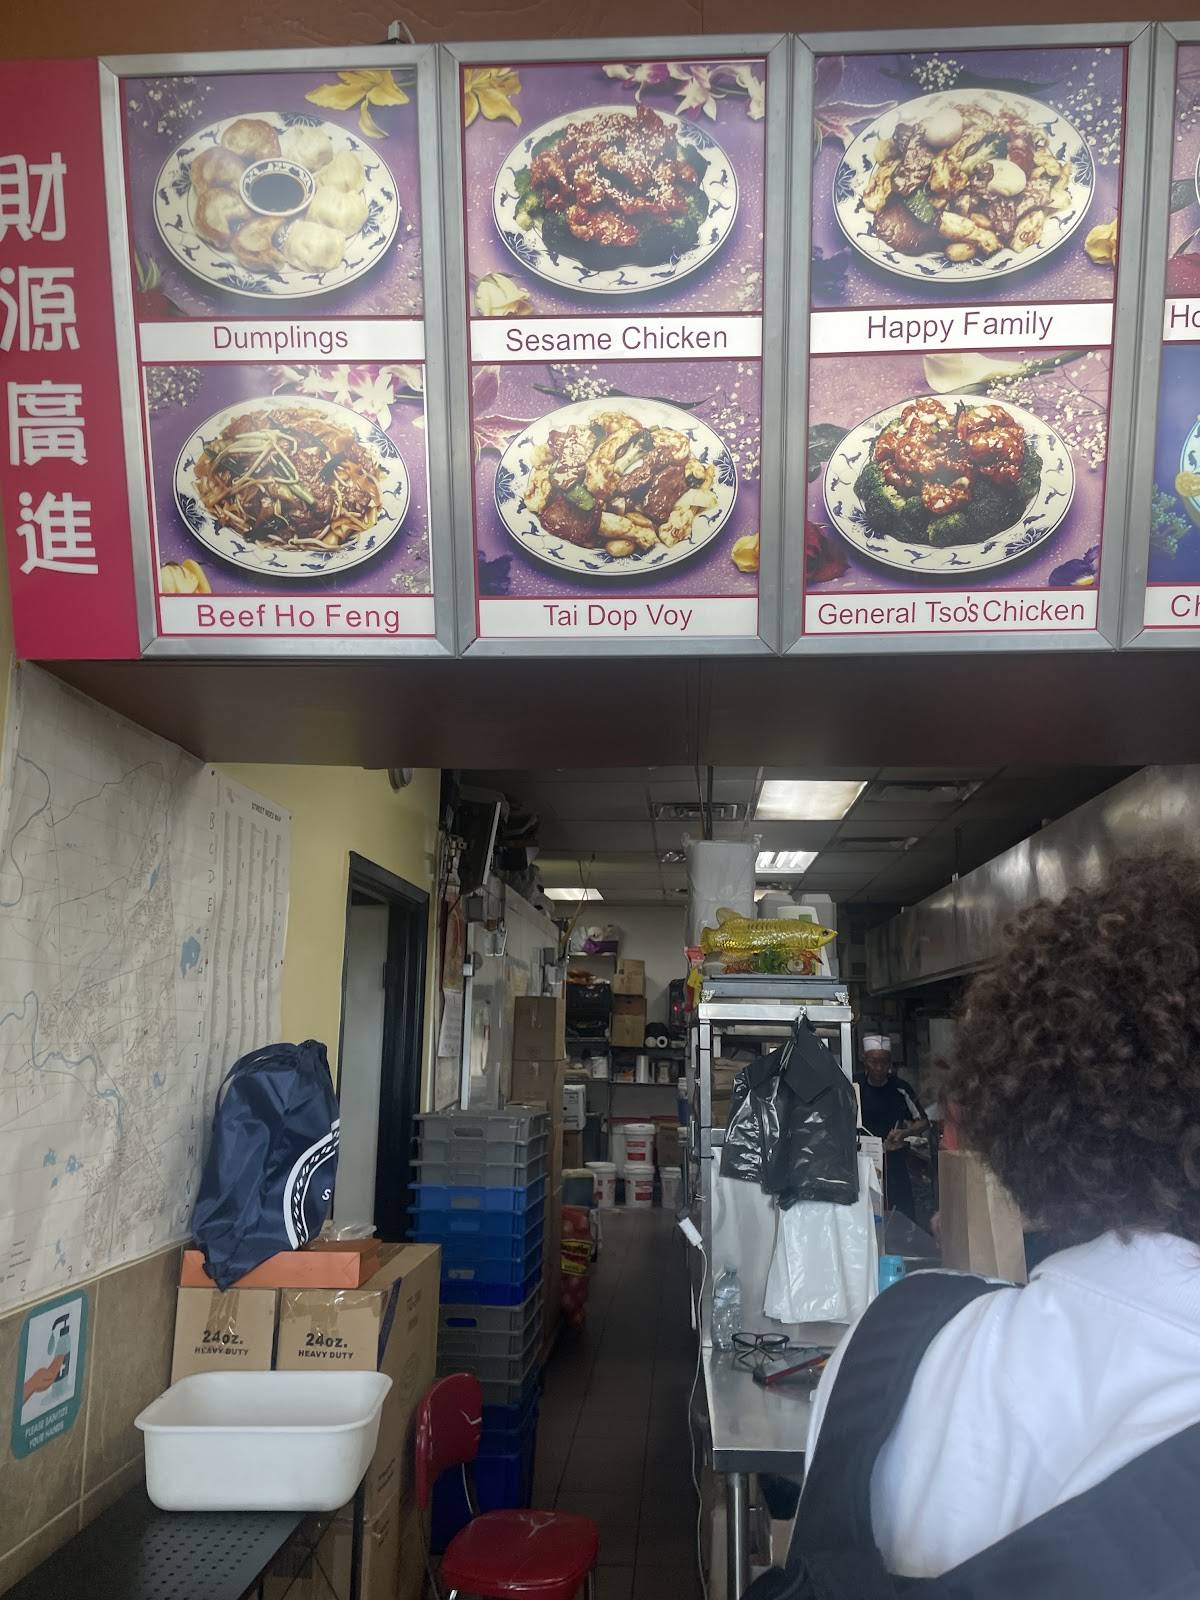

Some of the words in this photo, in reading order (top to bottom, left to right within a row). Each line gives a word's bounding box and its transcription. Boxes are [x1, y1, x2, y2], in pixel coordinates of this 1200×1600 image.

[506, 328, 612, 352] Sesame
[622, 325, 728, 350] Chicken
[868, 316, 955, 344] Happy
[963, 310, 1054, 341] Family
[213, 325, 348, 355] Dumplings
[0, 151, 99, 576] 財源廣進
[197, 603, 267, 628] Beef
[275, 604, 315, 628] Ho
[325, 604, 401, 634] Feng
[543, 604, 578, 627] Tai
[588, 603, 638, 631] Dop
[645, 603, 694, 631] Voy
[818, 601, 916, 625] General
[924, 595, 979, 623] Tso's
[983, 599, 1085, 622] Chicken
[321, 1188, 332, 1201] S
[202, 1328, 244, 1345] 24oz.
[305, 1332, 348, 1349] 24oz.
[194, 1346, 224, 1356] HEAVY
[225, 1347, 249, 1357] DUTY
[298, 1349, 328, 1359] HEAVY
[329, 1351, 354, 1360] DUTY
[25, 1419, 44, 1439] PLEASE
[29, 1431, 45, 1449] YOUR
